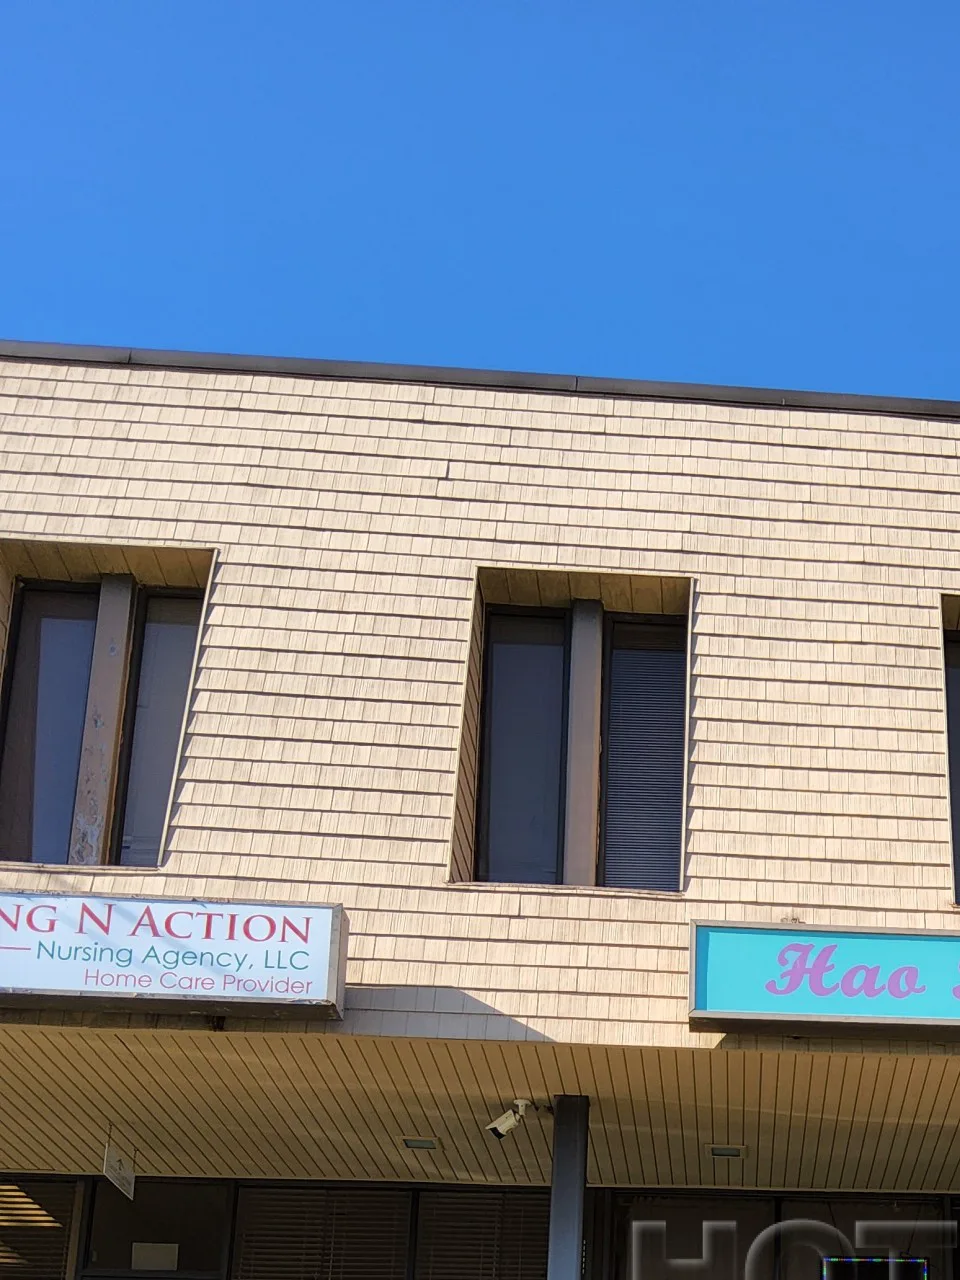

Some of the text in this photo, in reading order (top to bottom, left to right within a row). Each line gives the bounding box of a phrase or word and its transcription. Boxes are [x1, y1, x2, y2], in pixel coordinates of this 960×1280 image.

[76, 902, 116, 936] N
[127, 905, 313, 944] ACTION
[37, 940, 310, 972] Nursing Agency, LLC
[764, 941, 925, 999] Hao
[85, 968, 313, 994] Home Care Provider
